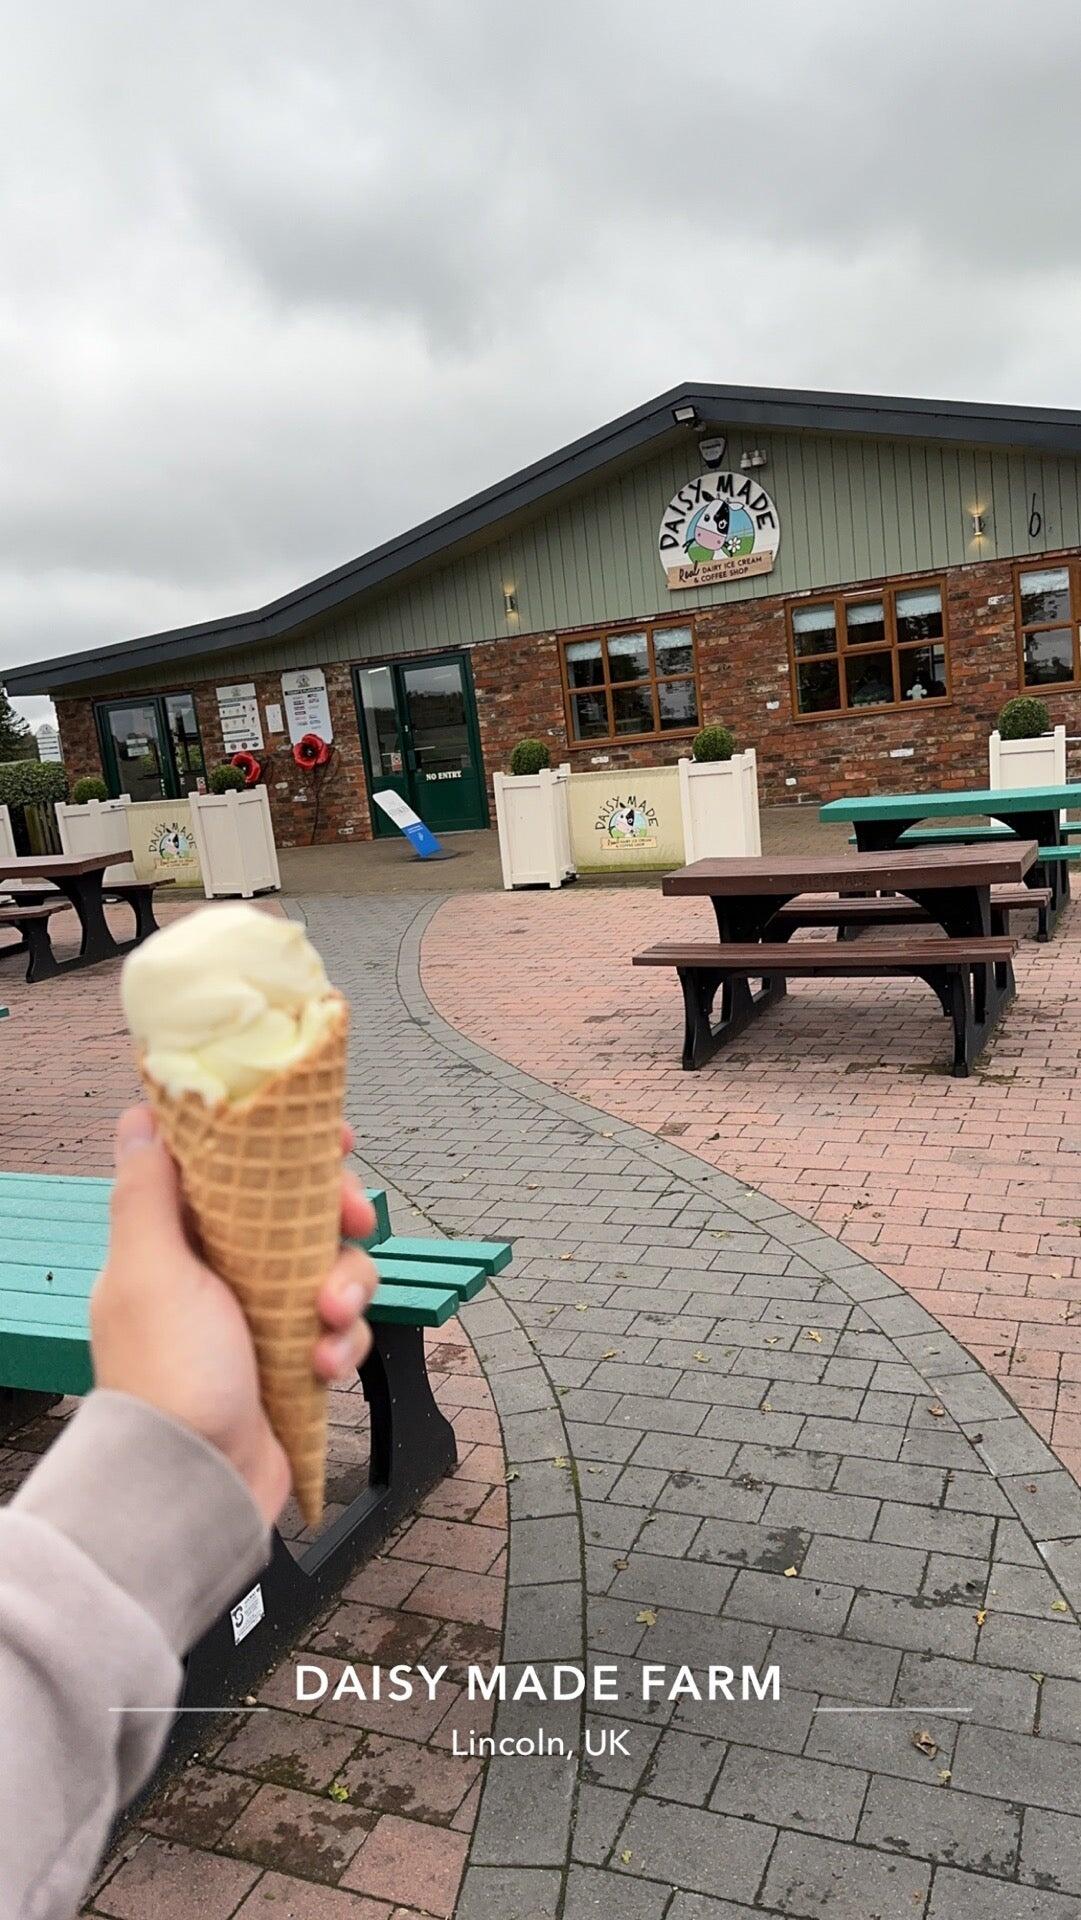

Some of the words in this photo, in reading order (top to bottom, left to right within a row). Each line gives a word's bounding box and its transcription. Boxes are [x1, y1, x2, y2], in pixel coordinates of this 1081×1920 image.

[660, 478, 702, 550] DAISY
[717, 474, 775, 529] MADE
[702, 564, 721, 573] DAIRY
[724, 561, 735, 570] ICE
[738, 557, 762, 566] CREAM
[701, 572, 727, 582] COFFEE
[729, 566, 749, 577] SHOP
[426, 773, 437, 781] NO
[438, 770, 462, 780] ENTRY
[595, 796, 620, 830] DAISY
[627, 795, 659, 827] MADE
